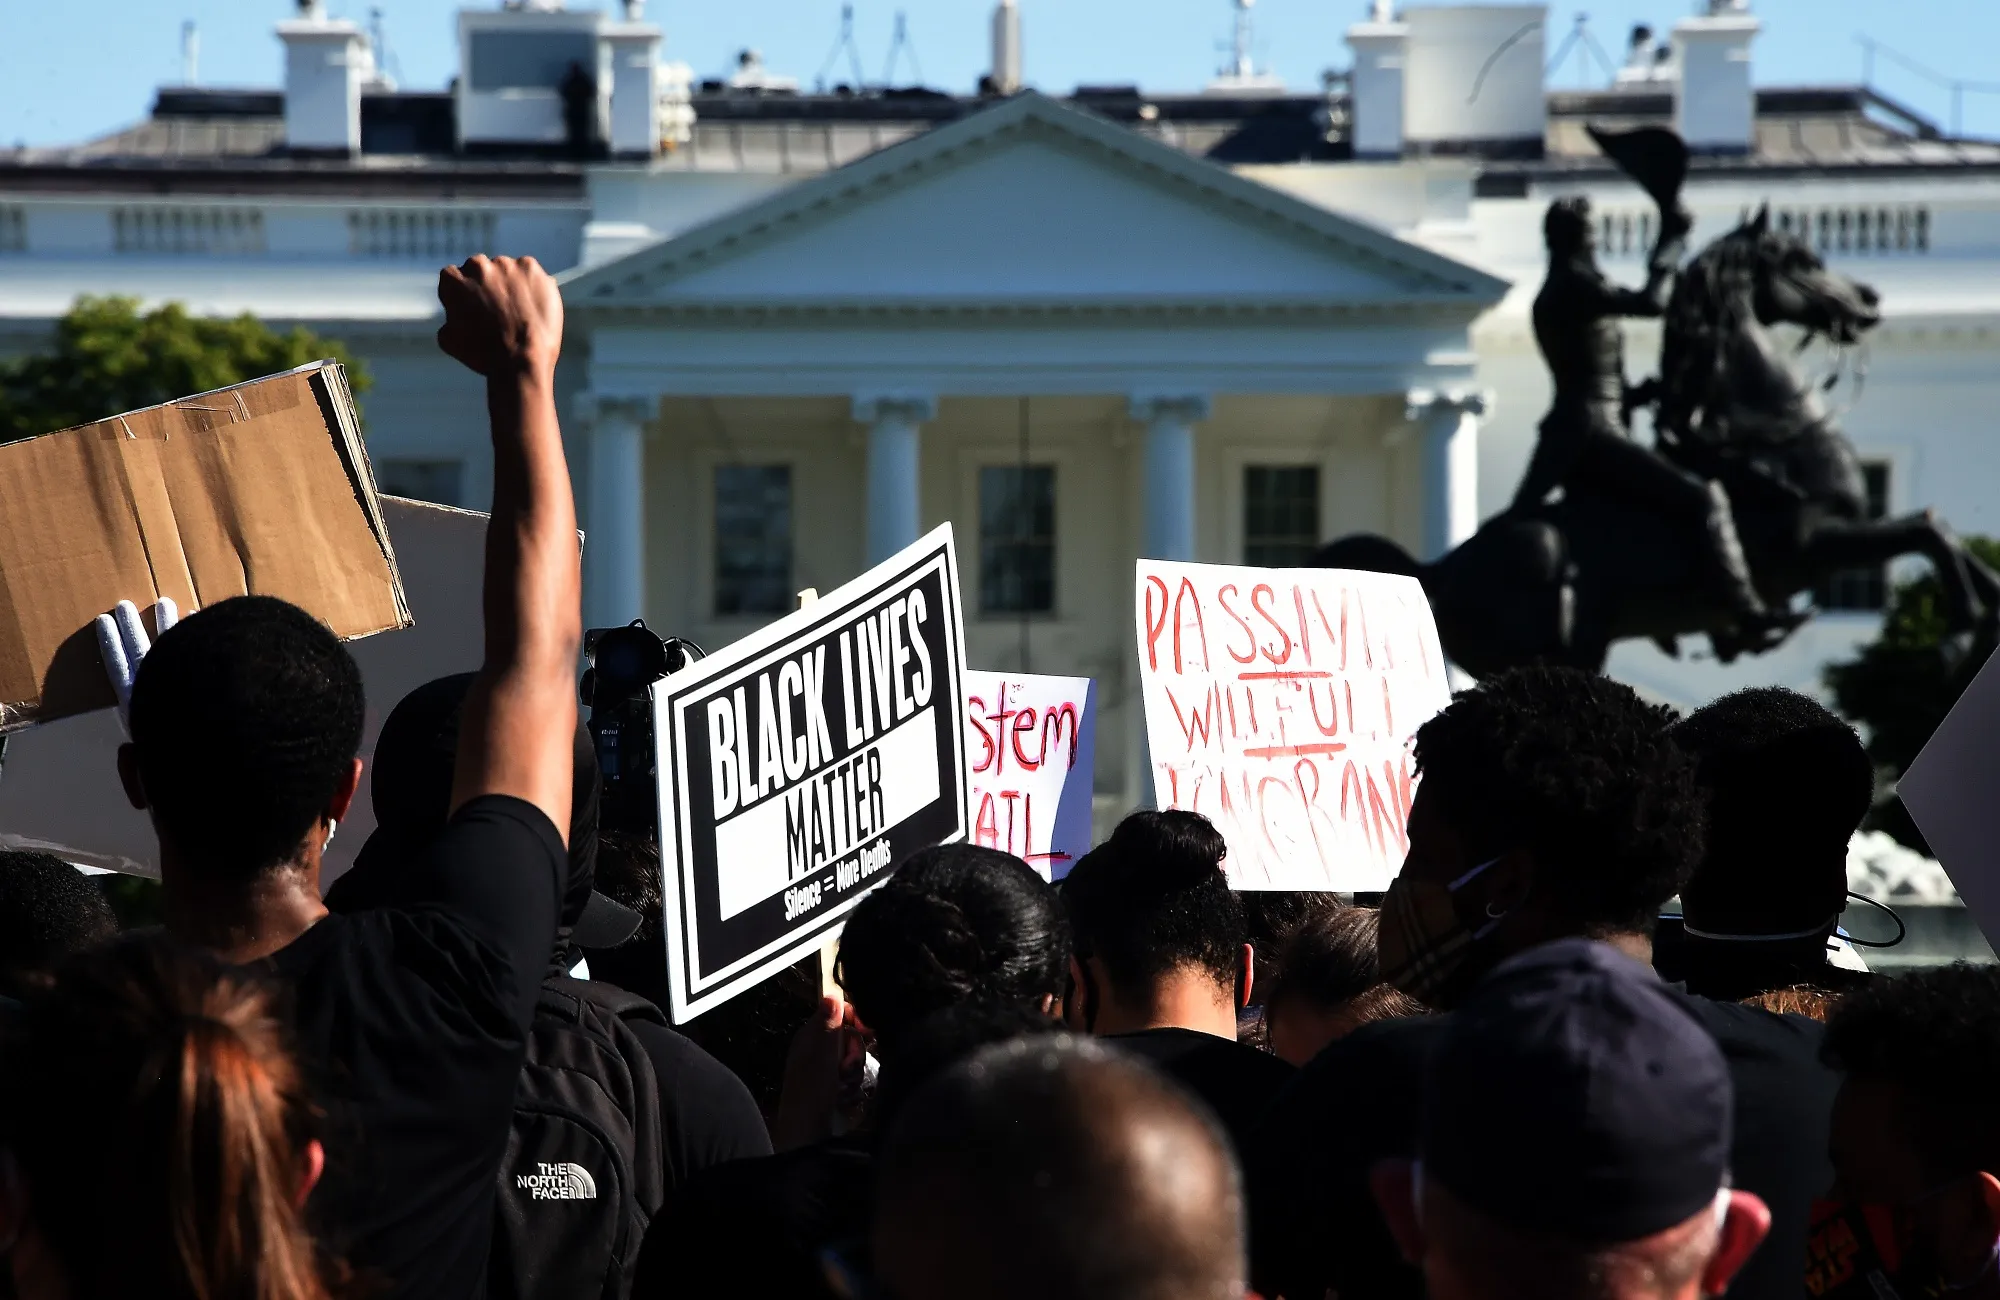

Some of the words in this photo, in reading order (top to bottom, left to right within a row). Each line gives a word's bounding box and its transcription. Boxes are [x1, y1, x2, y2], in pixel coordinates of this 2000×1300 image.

[707, 644, 834, 821] BLACK
[839, 588, 933, 750] LIVES
[785, 747, 885, 881] MATTER
[784, 880, 822, 921] Silence
[823, 875, 835, 892] =
[836, 858, 860, 893] More
[859, 837, 892, 879] Deaths
[517, 1174, 568, 1188] NORTH
[537, 1162, 568, 1175] THE
[532, 1187, 570, 1200] FACE
